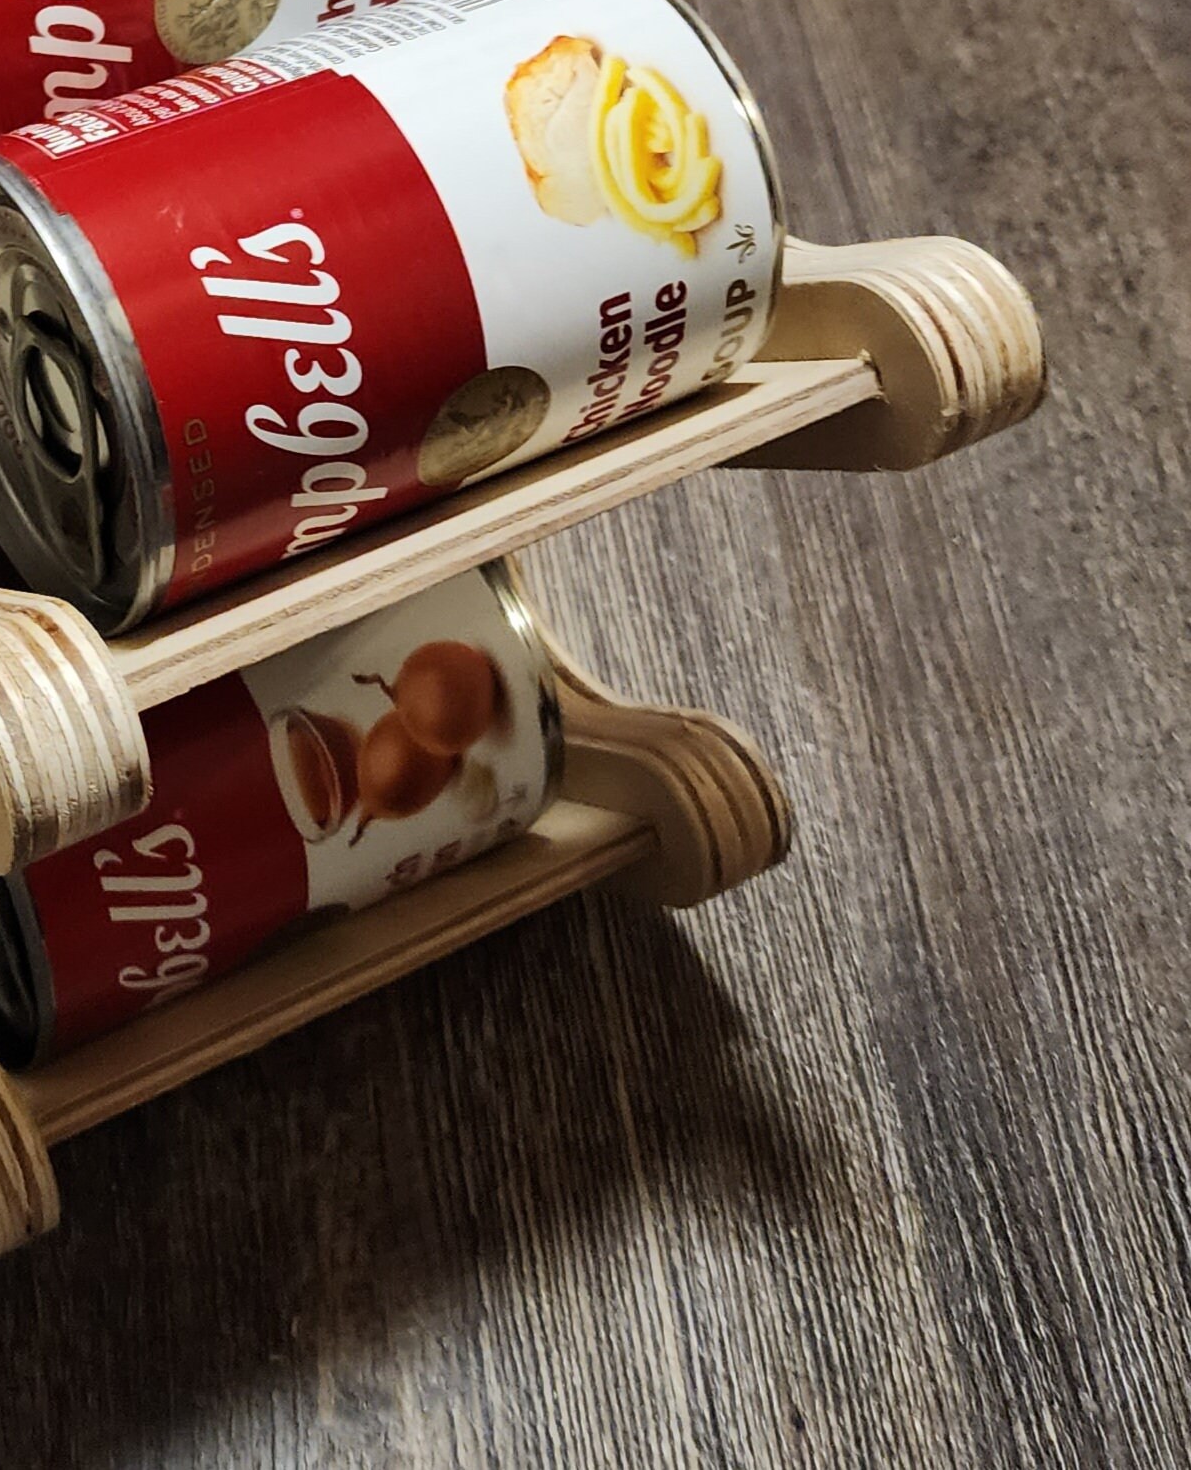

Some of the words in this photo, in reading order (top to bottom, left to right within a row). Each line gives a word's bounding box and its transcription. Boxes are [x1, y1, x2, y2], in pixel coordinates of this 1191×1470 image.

[560, 291, 632, 443] Chicken
[613, 280, 687, 420] Noodle
[700, 278, 755, 382] SOUP
[92, 823, 210, 1002] bell's
